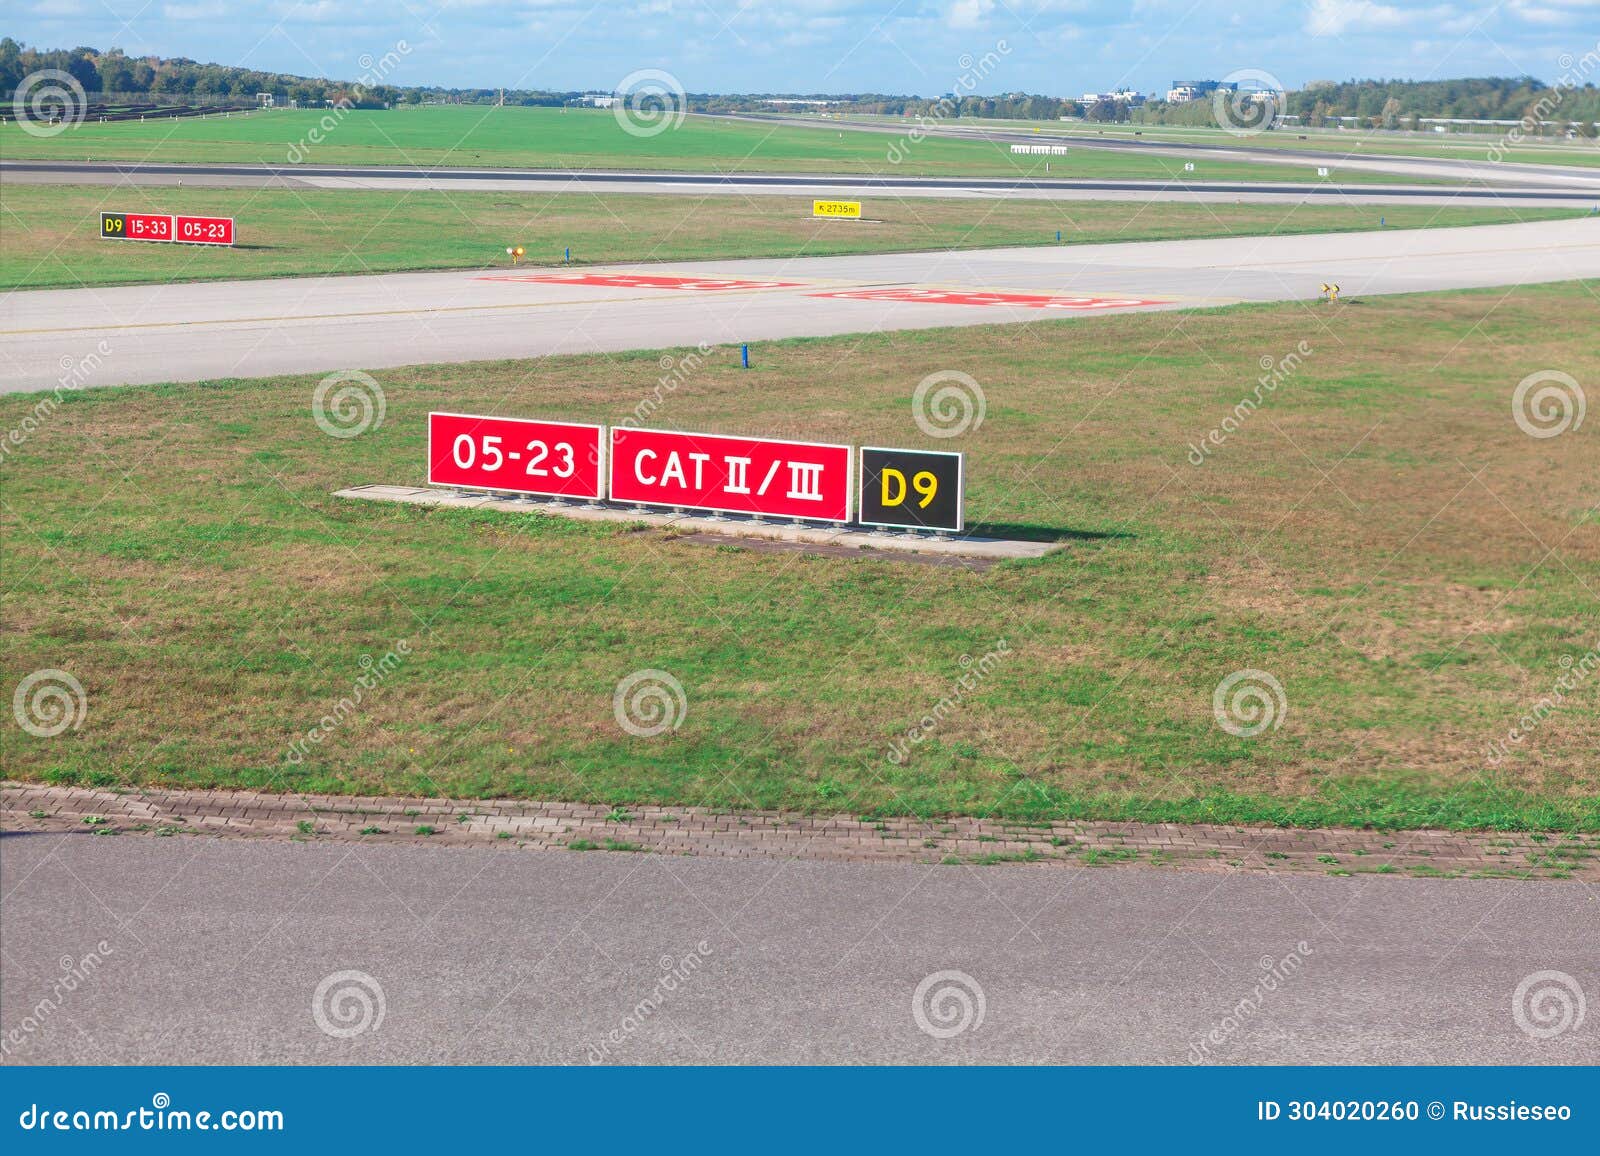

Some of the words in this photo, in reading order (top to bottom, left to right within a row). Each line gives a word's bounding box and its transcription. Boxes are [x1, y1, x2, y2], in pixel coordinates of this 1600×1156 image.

[105, 218, 123, 233] D9
[131, 220, 167, 235] 15-33
[184, 222, 225, 238] 05-23
[452, 433, 575, 478] 05-23
[634, 448, 710, 490] CAT
[880, 467, 938, 509] D9
